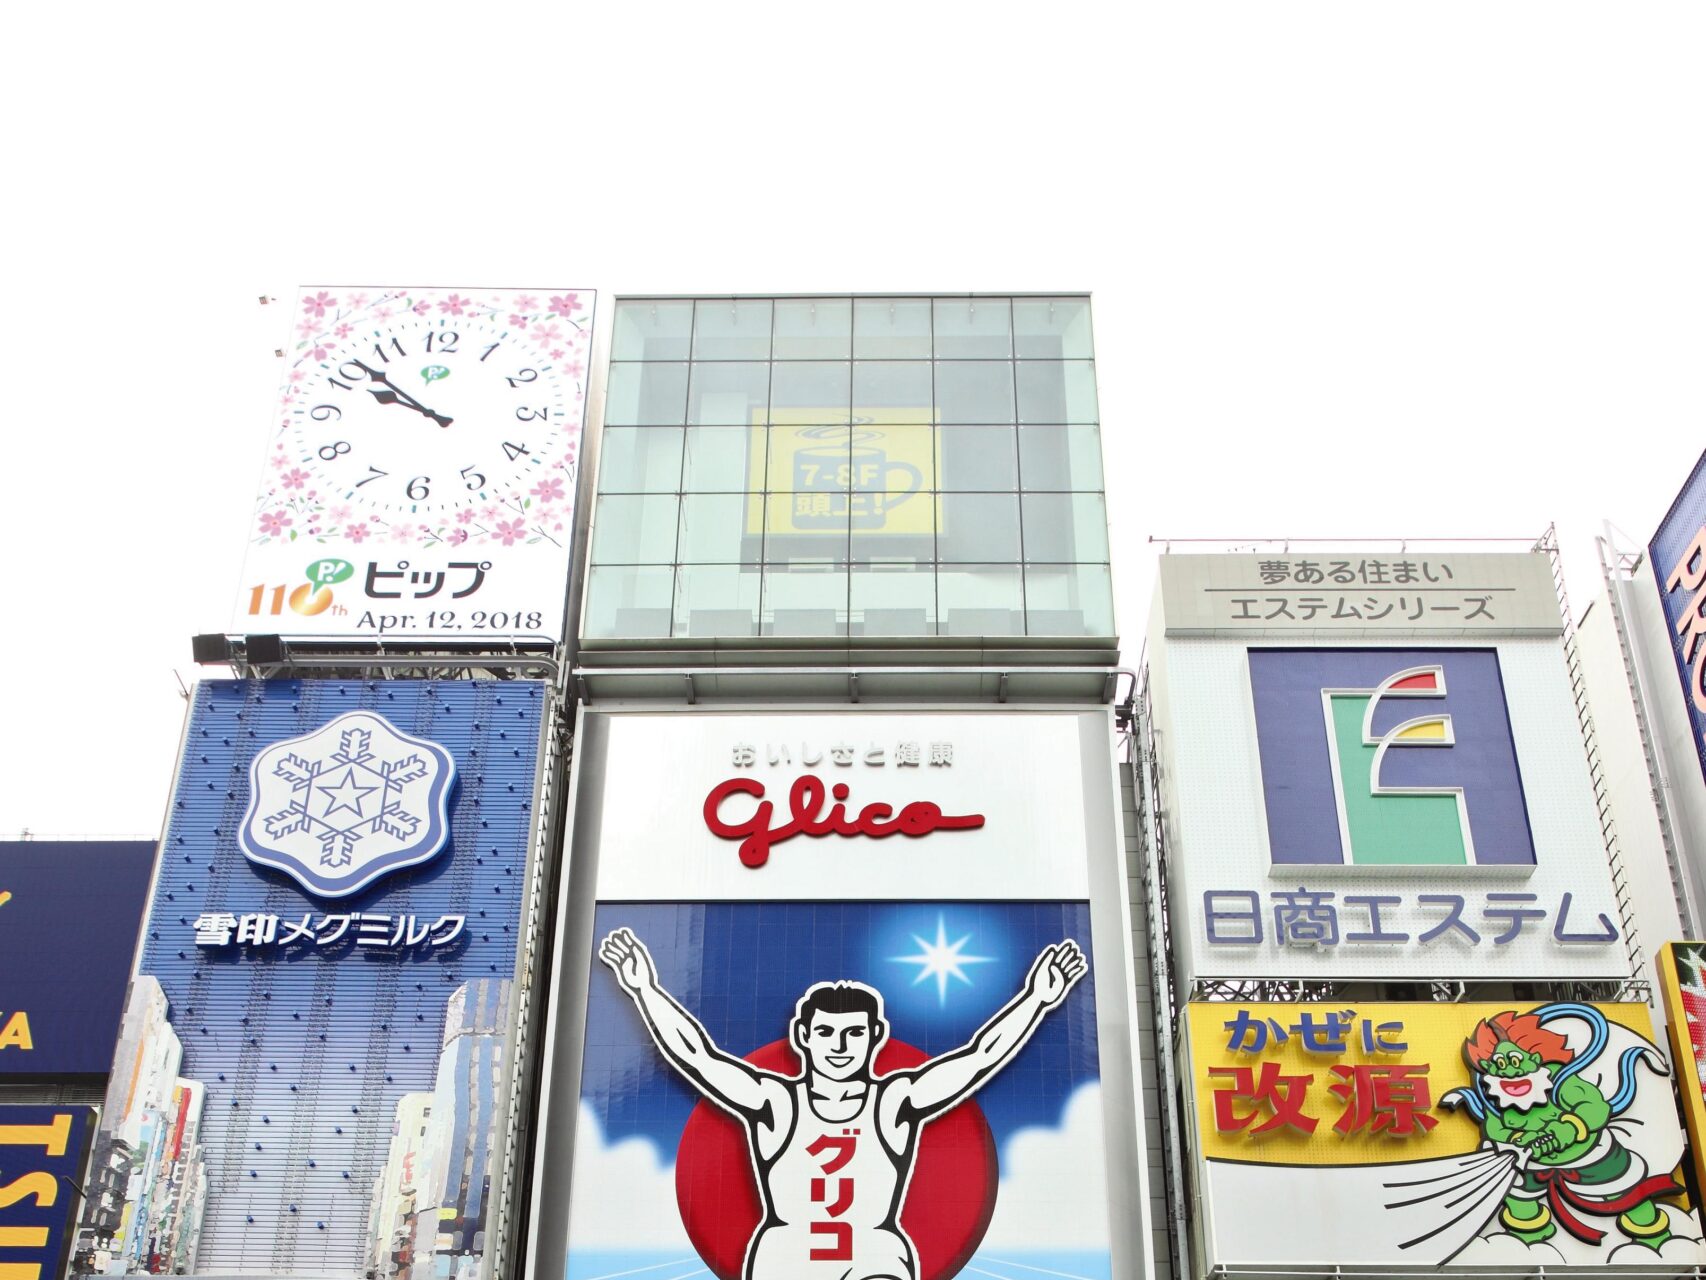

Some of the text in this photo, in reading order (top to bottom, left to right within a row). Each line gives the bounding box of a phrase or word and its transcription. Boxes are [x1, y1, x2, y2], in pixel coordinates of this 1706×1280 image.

[372, 337, 407, 363] 11
[422, 331, 459, 353] 12
[479, 341, 501, 362] 1
[328, 361, 369, 391] 10
[506, 368, 538, 389] 2
[310, 404, 342, 421] 9
[515, 406, 548, 422] 3
[318, 440, 351, 461] 8
[501, 440, 531, 462] 4
[355, 466, 389, 489] 7
[460, 465, 486, 490] 5
[800, 464, 880, 486] 7-8F
[405, 476, 431, 501] 6
[364, 560, 493, 599] ピップ
[1258, 560, 1454, 585] 夢ある住まい
[1230, 595, 1495, 621] エステムシリーズ
[356, 610, 543, 634] Apr. 12, 2018
[733, 742, 953, 768] おいしさと健康
[704, 775, 985, 869] Glico
[1202, 886, 1621, 947] 日商エステム
[192, 913, 466, 947] 雪印メグミルク
[1224, 1009, 1409, 1057] かぜに
[1208, 1062, 1440, 1139] 改源
[805, 1128, 861, 1261] グリコ
